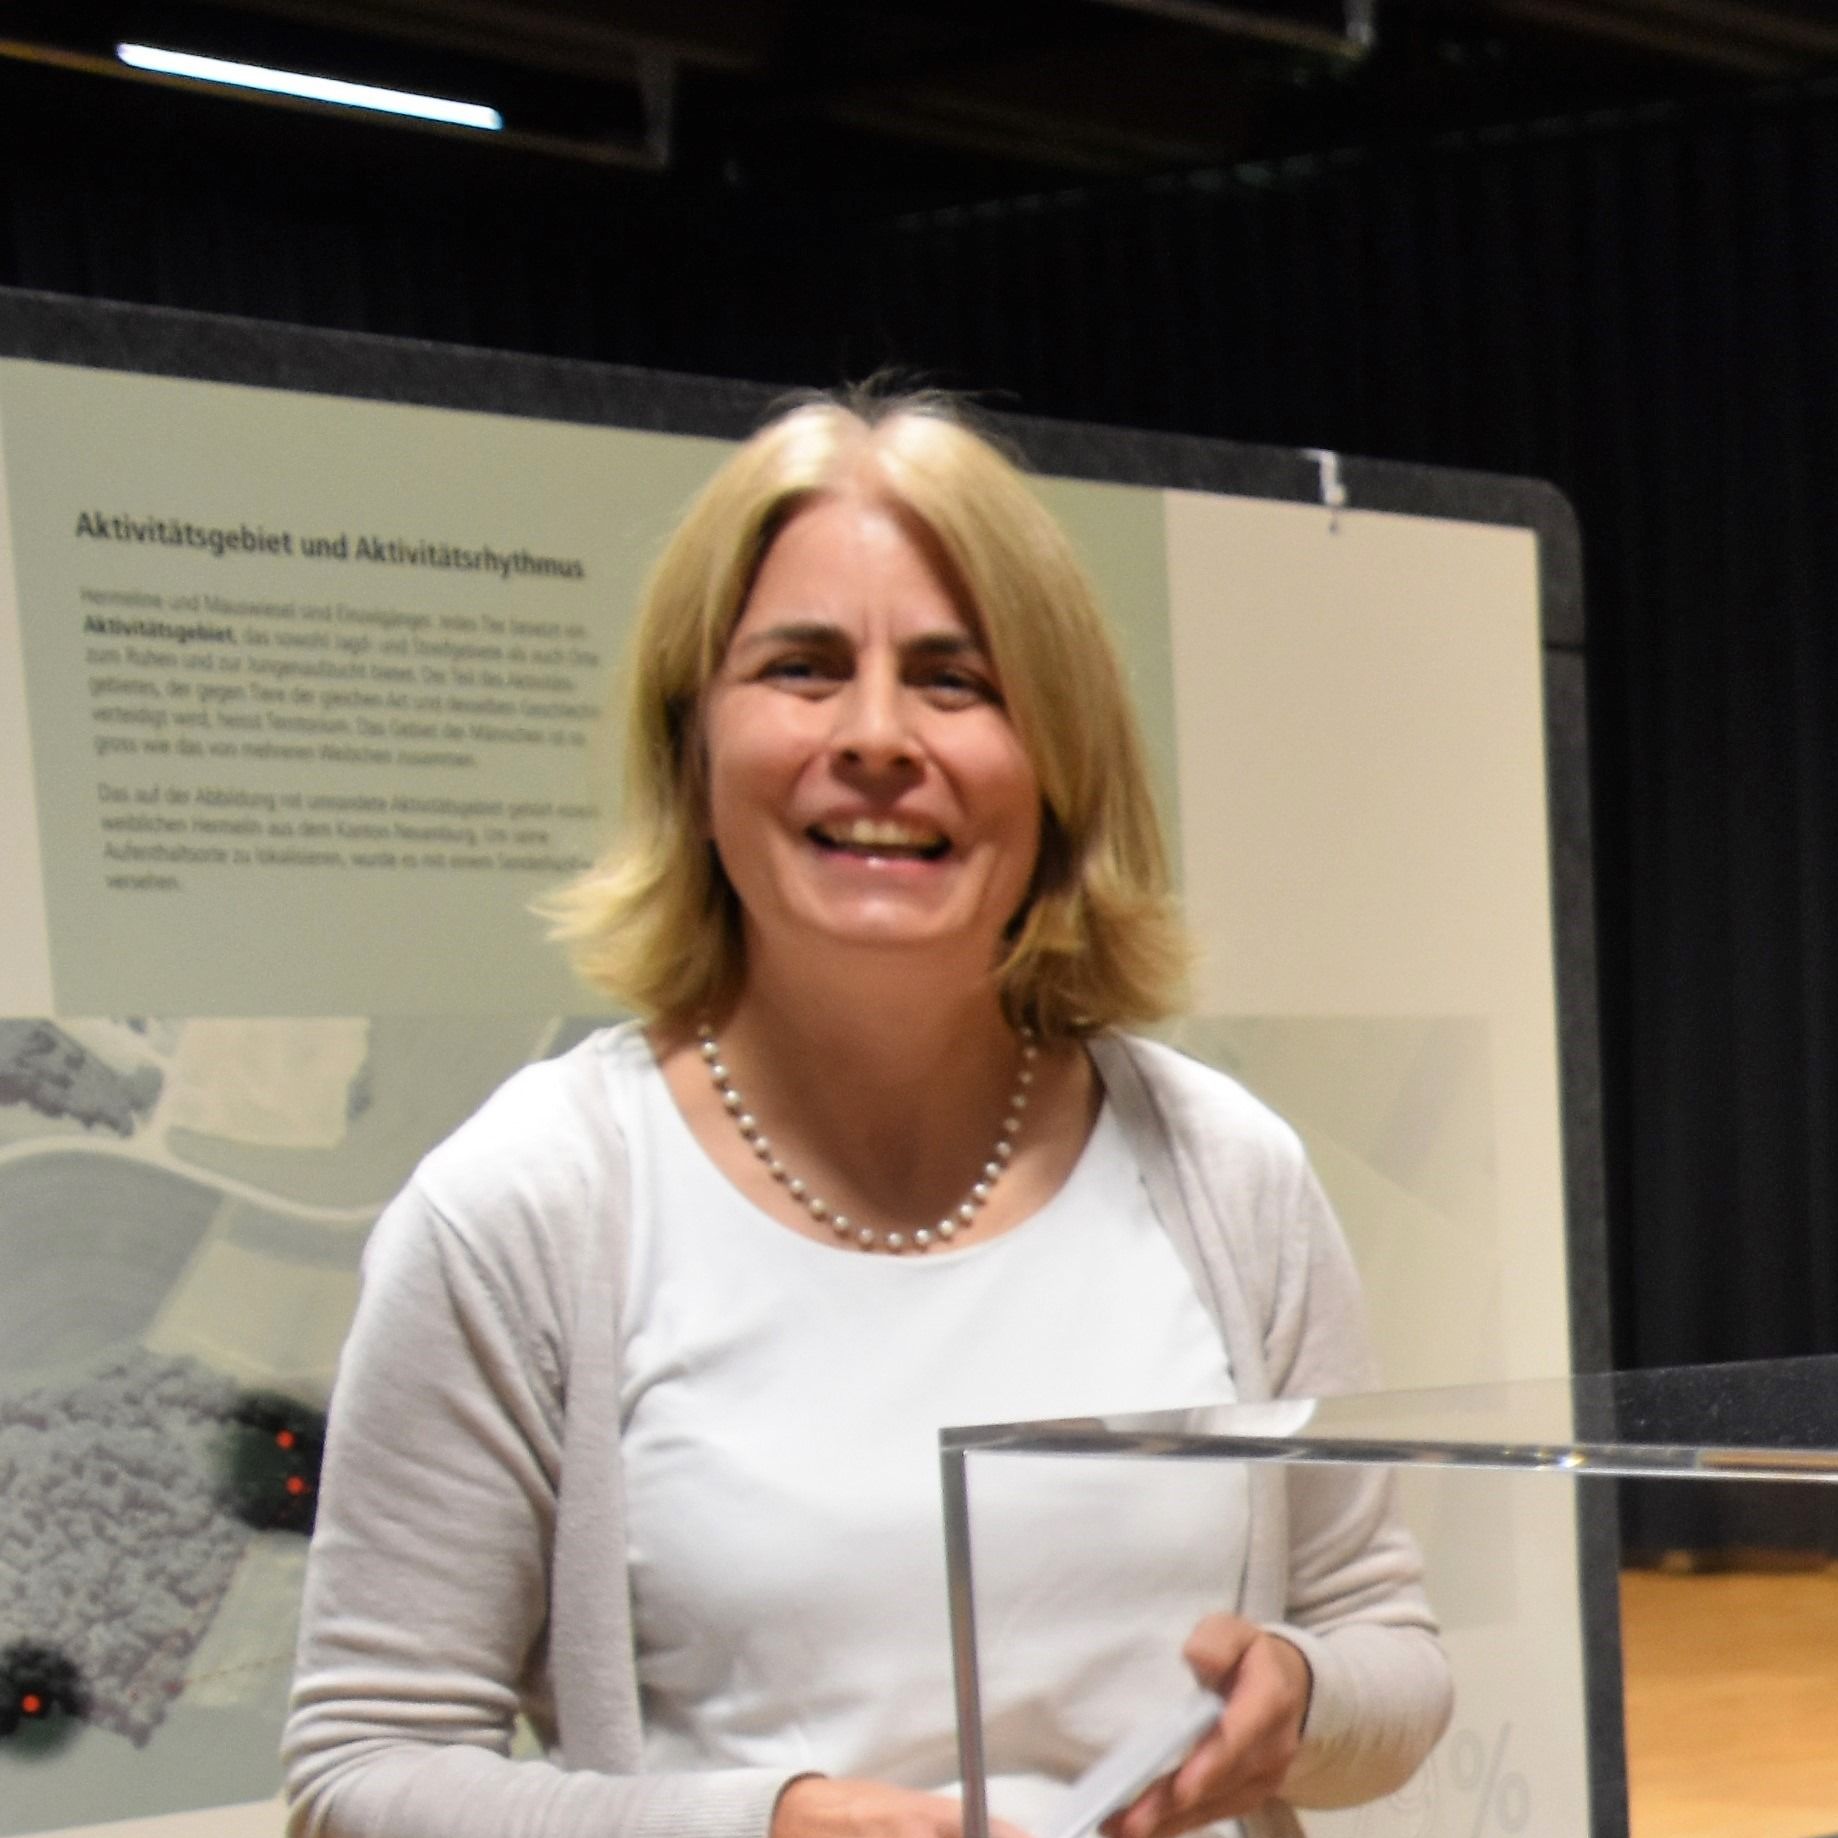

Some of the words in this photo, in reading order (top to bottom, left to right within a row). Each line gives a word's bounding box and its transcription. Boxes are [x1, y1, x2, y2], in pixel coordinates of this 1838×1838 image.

[76, 511, 293, 559] Aktivitätsgebiet
[301, 532, 350, 563] und
[355, 536, 585, 581] Aktivitätsrhythmus
